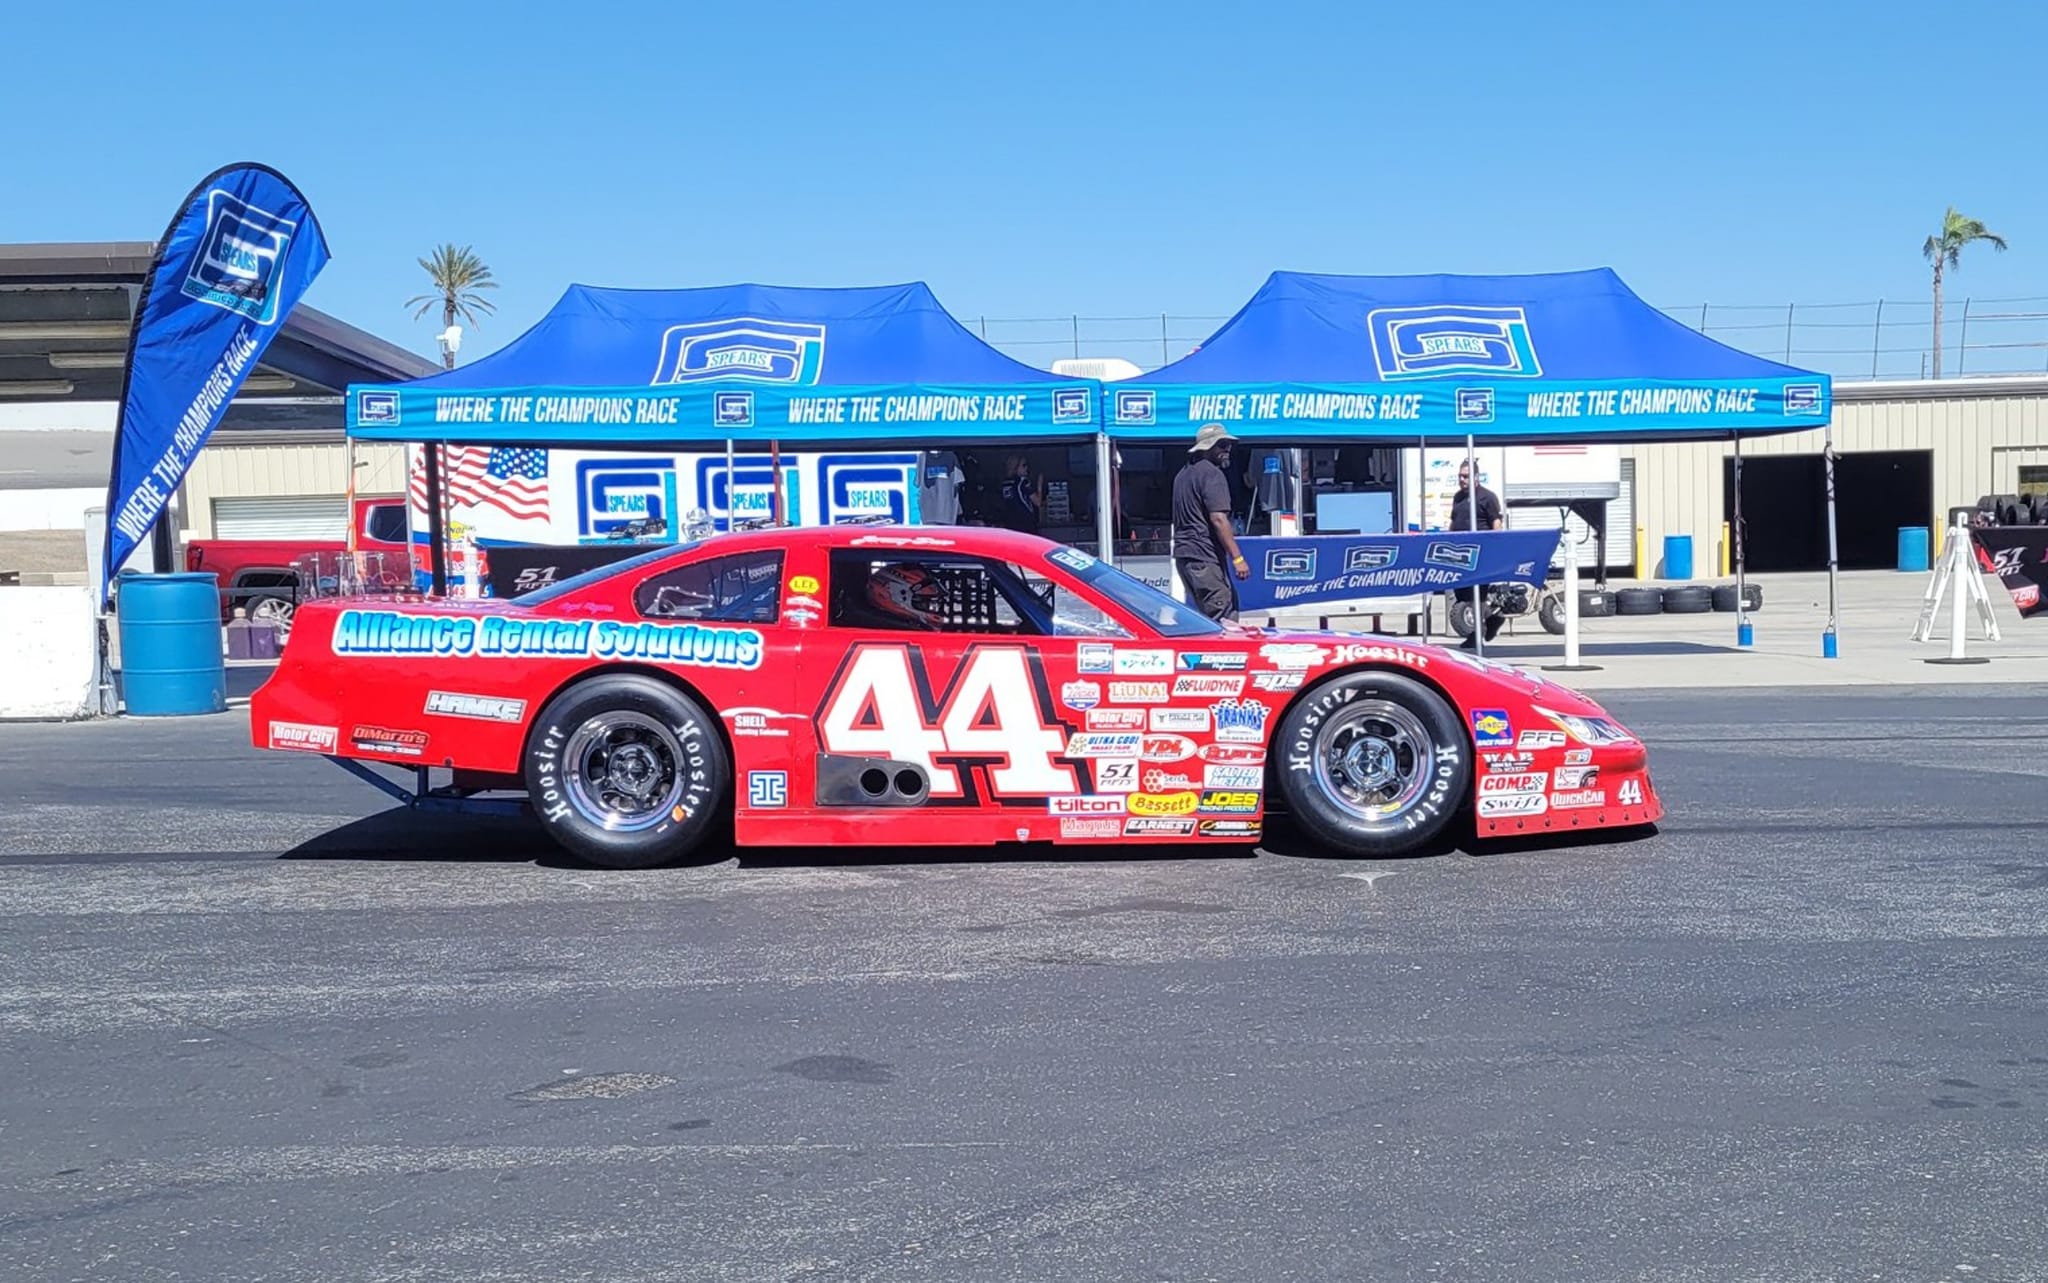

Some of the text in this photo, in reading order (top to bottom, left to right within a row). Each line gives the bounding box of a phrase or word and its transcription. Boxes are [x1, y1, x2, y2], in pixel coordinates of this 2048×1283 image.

[1425, 337, 1482, 354] SPEARS
[710, 350, 768, 369] SPEARS
[435, 397, 680, 424] WHERE THE CHAMPIONS RACE
[788, 395, 1027, 424] WHERE THE CHAMPIONS RACE
[1188, 394, 1423, 421] WHERE THE CHAMPIONS RACE
[1527, 388, 1759, 418] WHERE THE CHAMPIONS RACE
[116, 476, 167, 542] WHERE
[152, 445, 185, 489] THE
[173, 363, 233, 456] CHAMPIONS
[224, 323, 258, 376] RACE
[608, 495, 646, 512] SPEARS
[733, 493, 767, 510] SPEARS
[850, 490, 887, 508] SPEARS
[1994, 547, 2028, 569] 51
[513, 567, 559, 584] 51
[794, 580, 814, 589] LEE
[1274, 582, 1322, 599] WHERE
[1322, 575, 1347, 591] THE
[1349, 568, 1424, 588] CHAMPIONS
[337, 611, 762, 666] Alliance Rental Solutions
[1329, 643, 1429, 669] Hoosier
[1112, 684, 1165, 697] LiUNA!
[1188, 679, 1240, 692] FLUIDYNE
[428, 693, 522, 720] HAMKE
[735, 715, 767, 728] SHELL
[820, 643, 1079, 797] 44
[273, 724, 308, 743] Motor
[308, 728, 335, 747] City
[1288, 688, 1347, 774] Hoosier
[1520, 731, 1565, 743] PFC
[533, 724, 573, 823] Hoosier
[671, 719, 711, 818] Hoosier
[1100, 763, 1135, 778] 51
[1406, 743, 1459, 830] Hoosier
[1484, 776, 1532, 791] COMP
[1618, 779, 1643, 805] 44
[1054, 799, 1121, 811] tilton
[1135, 796, 1191, 812] Bassett
[1202, 792, 1259, 806] JOES
[1482, 795, 1543, 810] Swift
[1128, 820, 1195, 830] EARNEST
